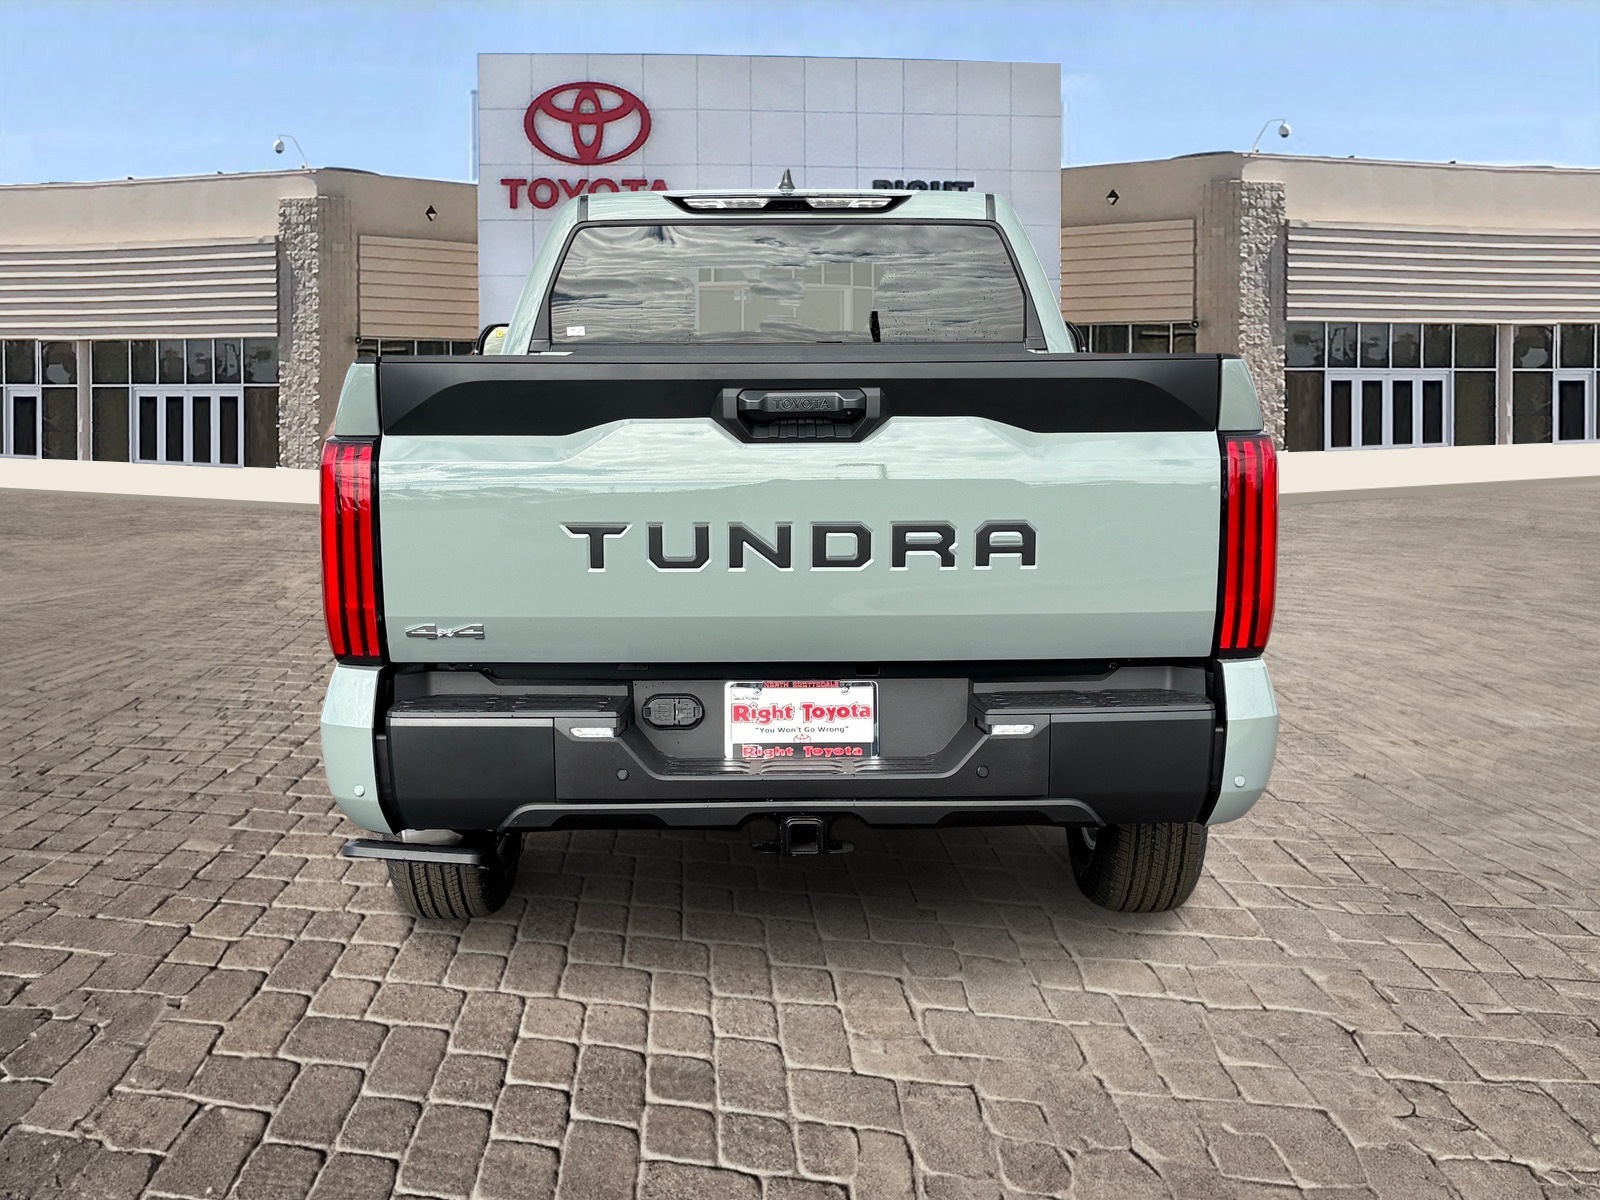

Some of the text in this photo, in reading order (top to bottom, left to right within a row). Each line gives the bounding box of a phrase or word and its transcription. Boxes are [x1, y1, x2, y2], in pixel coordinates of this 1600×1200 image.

[772, 398, 831, 410] TOYOTA
[559, 520, 1038, 573] TUNDRA
[732, 702, 872, 725] Right Toyota
[742, 744, 863, 758] Right Toyota
